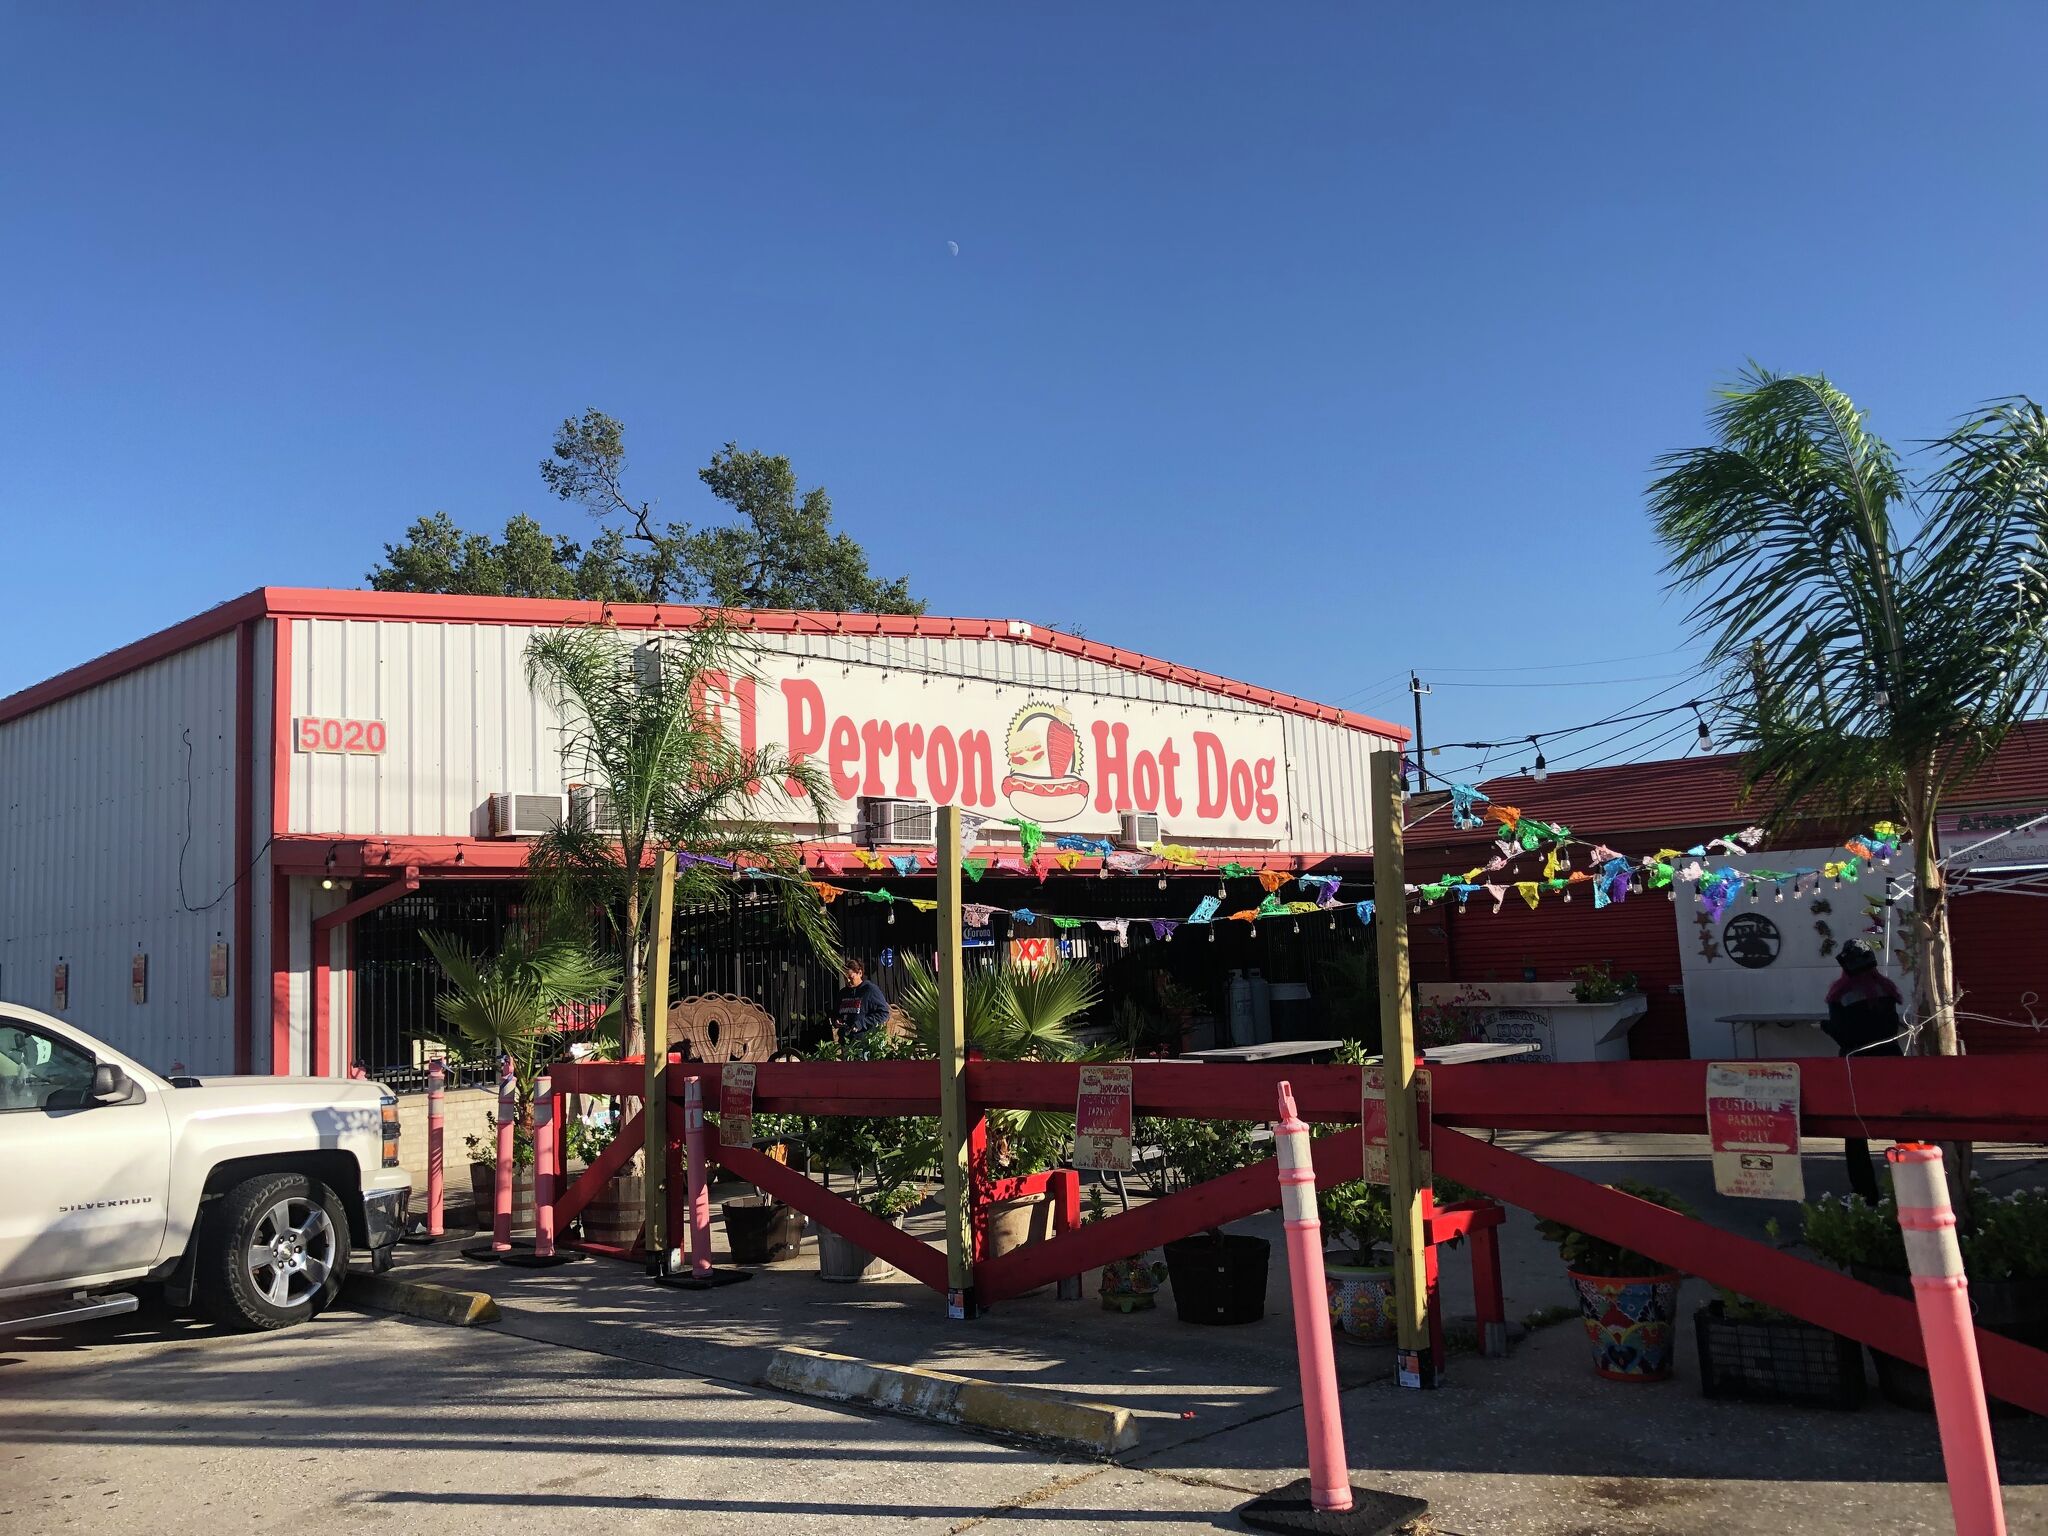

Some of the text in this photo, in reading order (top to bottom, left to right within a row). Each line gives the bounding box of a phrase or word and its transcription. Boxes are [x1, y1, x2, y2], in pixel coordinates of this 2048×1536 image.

[301, 718, 386, 752] 5020
[688, 667, 1279, 824] El Perron Hot Dog
[963, 927, 991, 940] Corona
[1016, 938, 1049, 960] XX
[1496, 1023, 1535, 1038] HOT
[1728, 1114, 1775, 1127] PARKING
[1738, 1129, 1771, 1142] ONLY
[59, 1197, 152, 1213] SILVERADO
